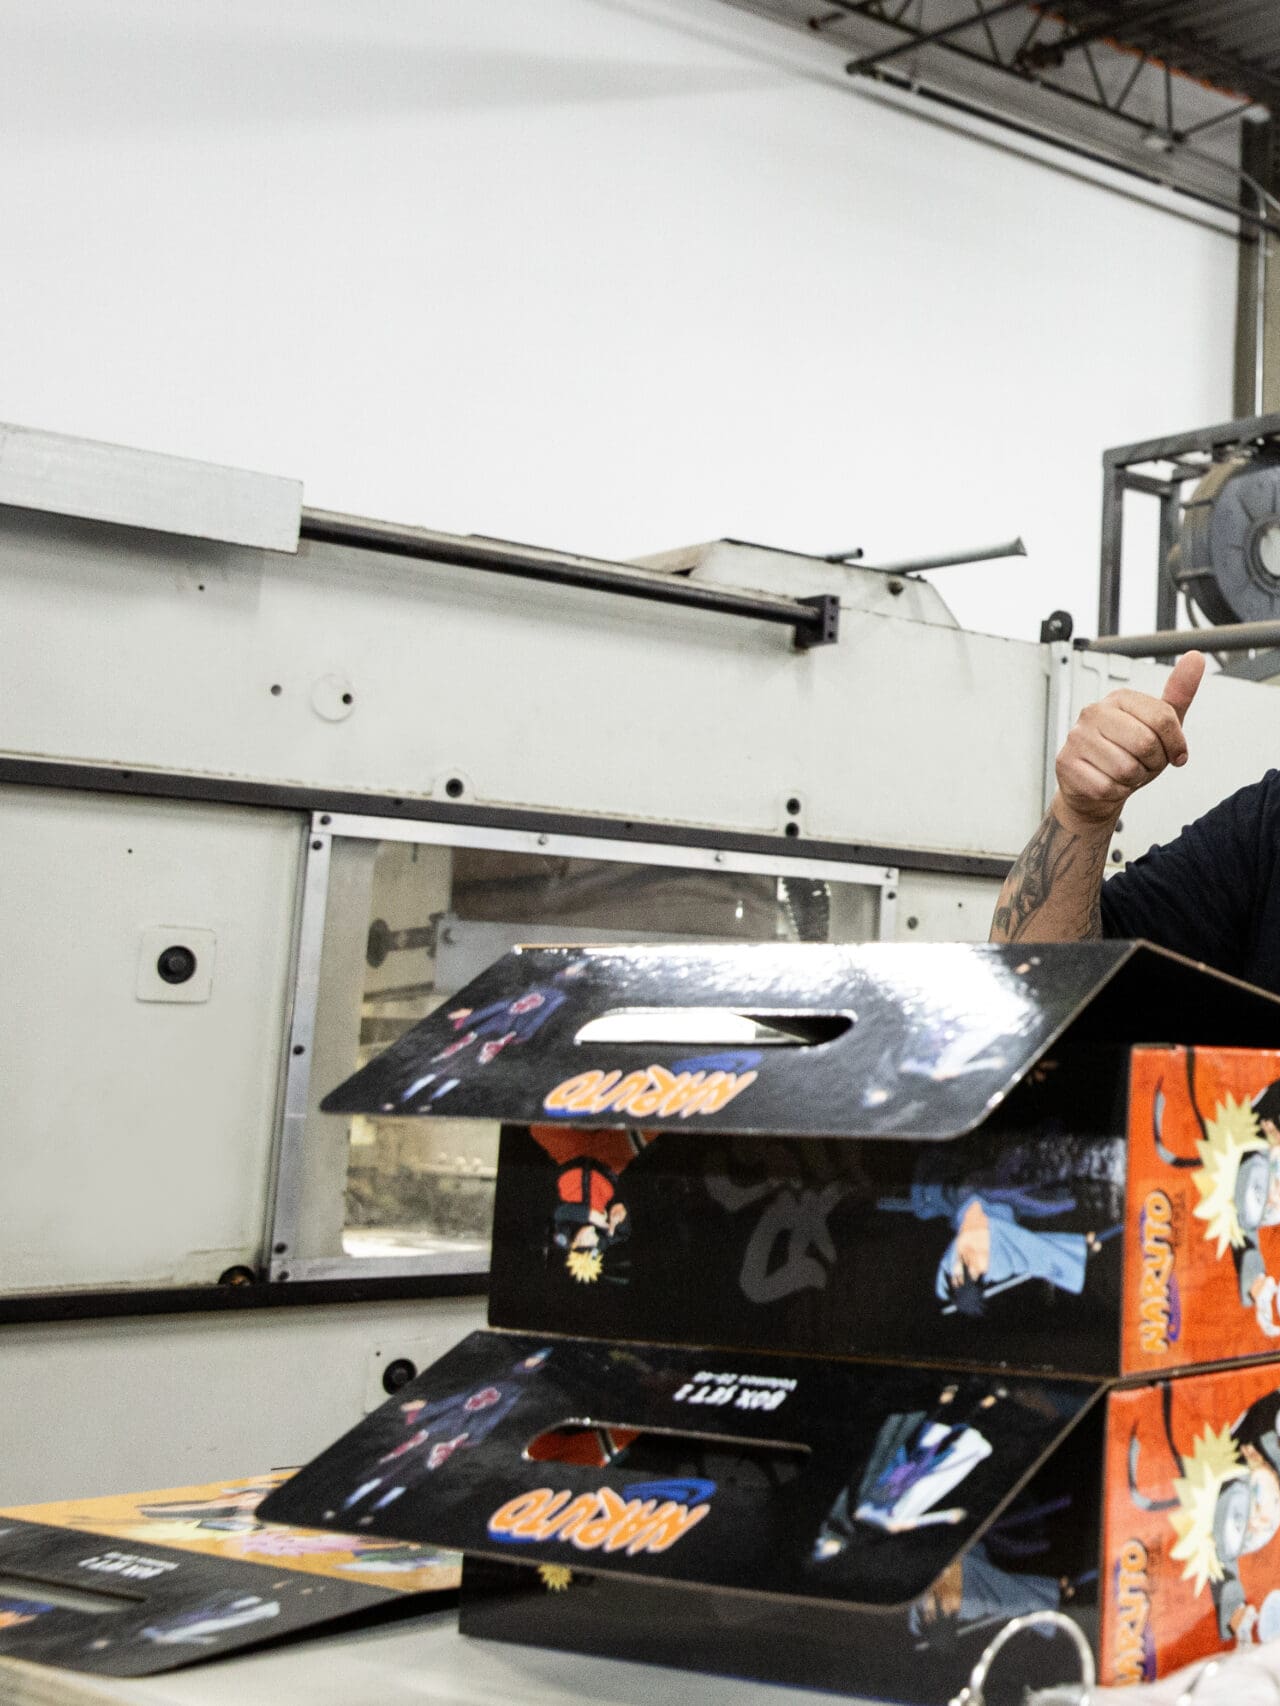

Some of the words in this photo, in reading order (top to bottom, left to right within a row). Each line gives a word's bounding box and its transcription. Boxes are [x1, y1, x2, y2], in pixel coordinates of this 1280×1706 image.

[543, 1064, 759, 1119] NARUTO
[1139, 1190, 1173, 1354] NARUTO
[487, 1486, 712, 1557] NARUTO
[1113, 1539, 1150, 1688] ARUTO
